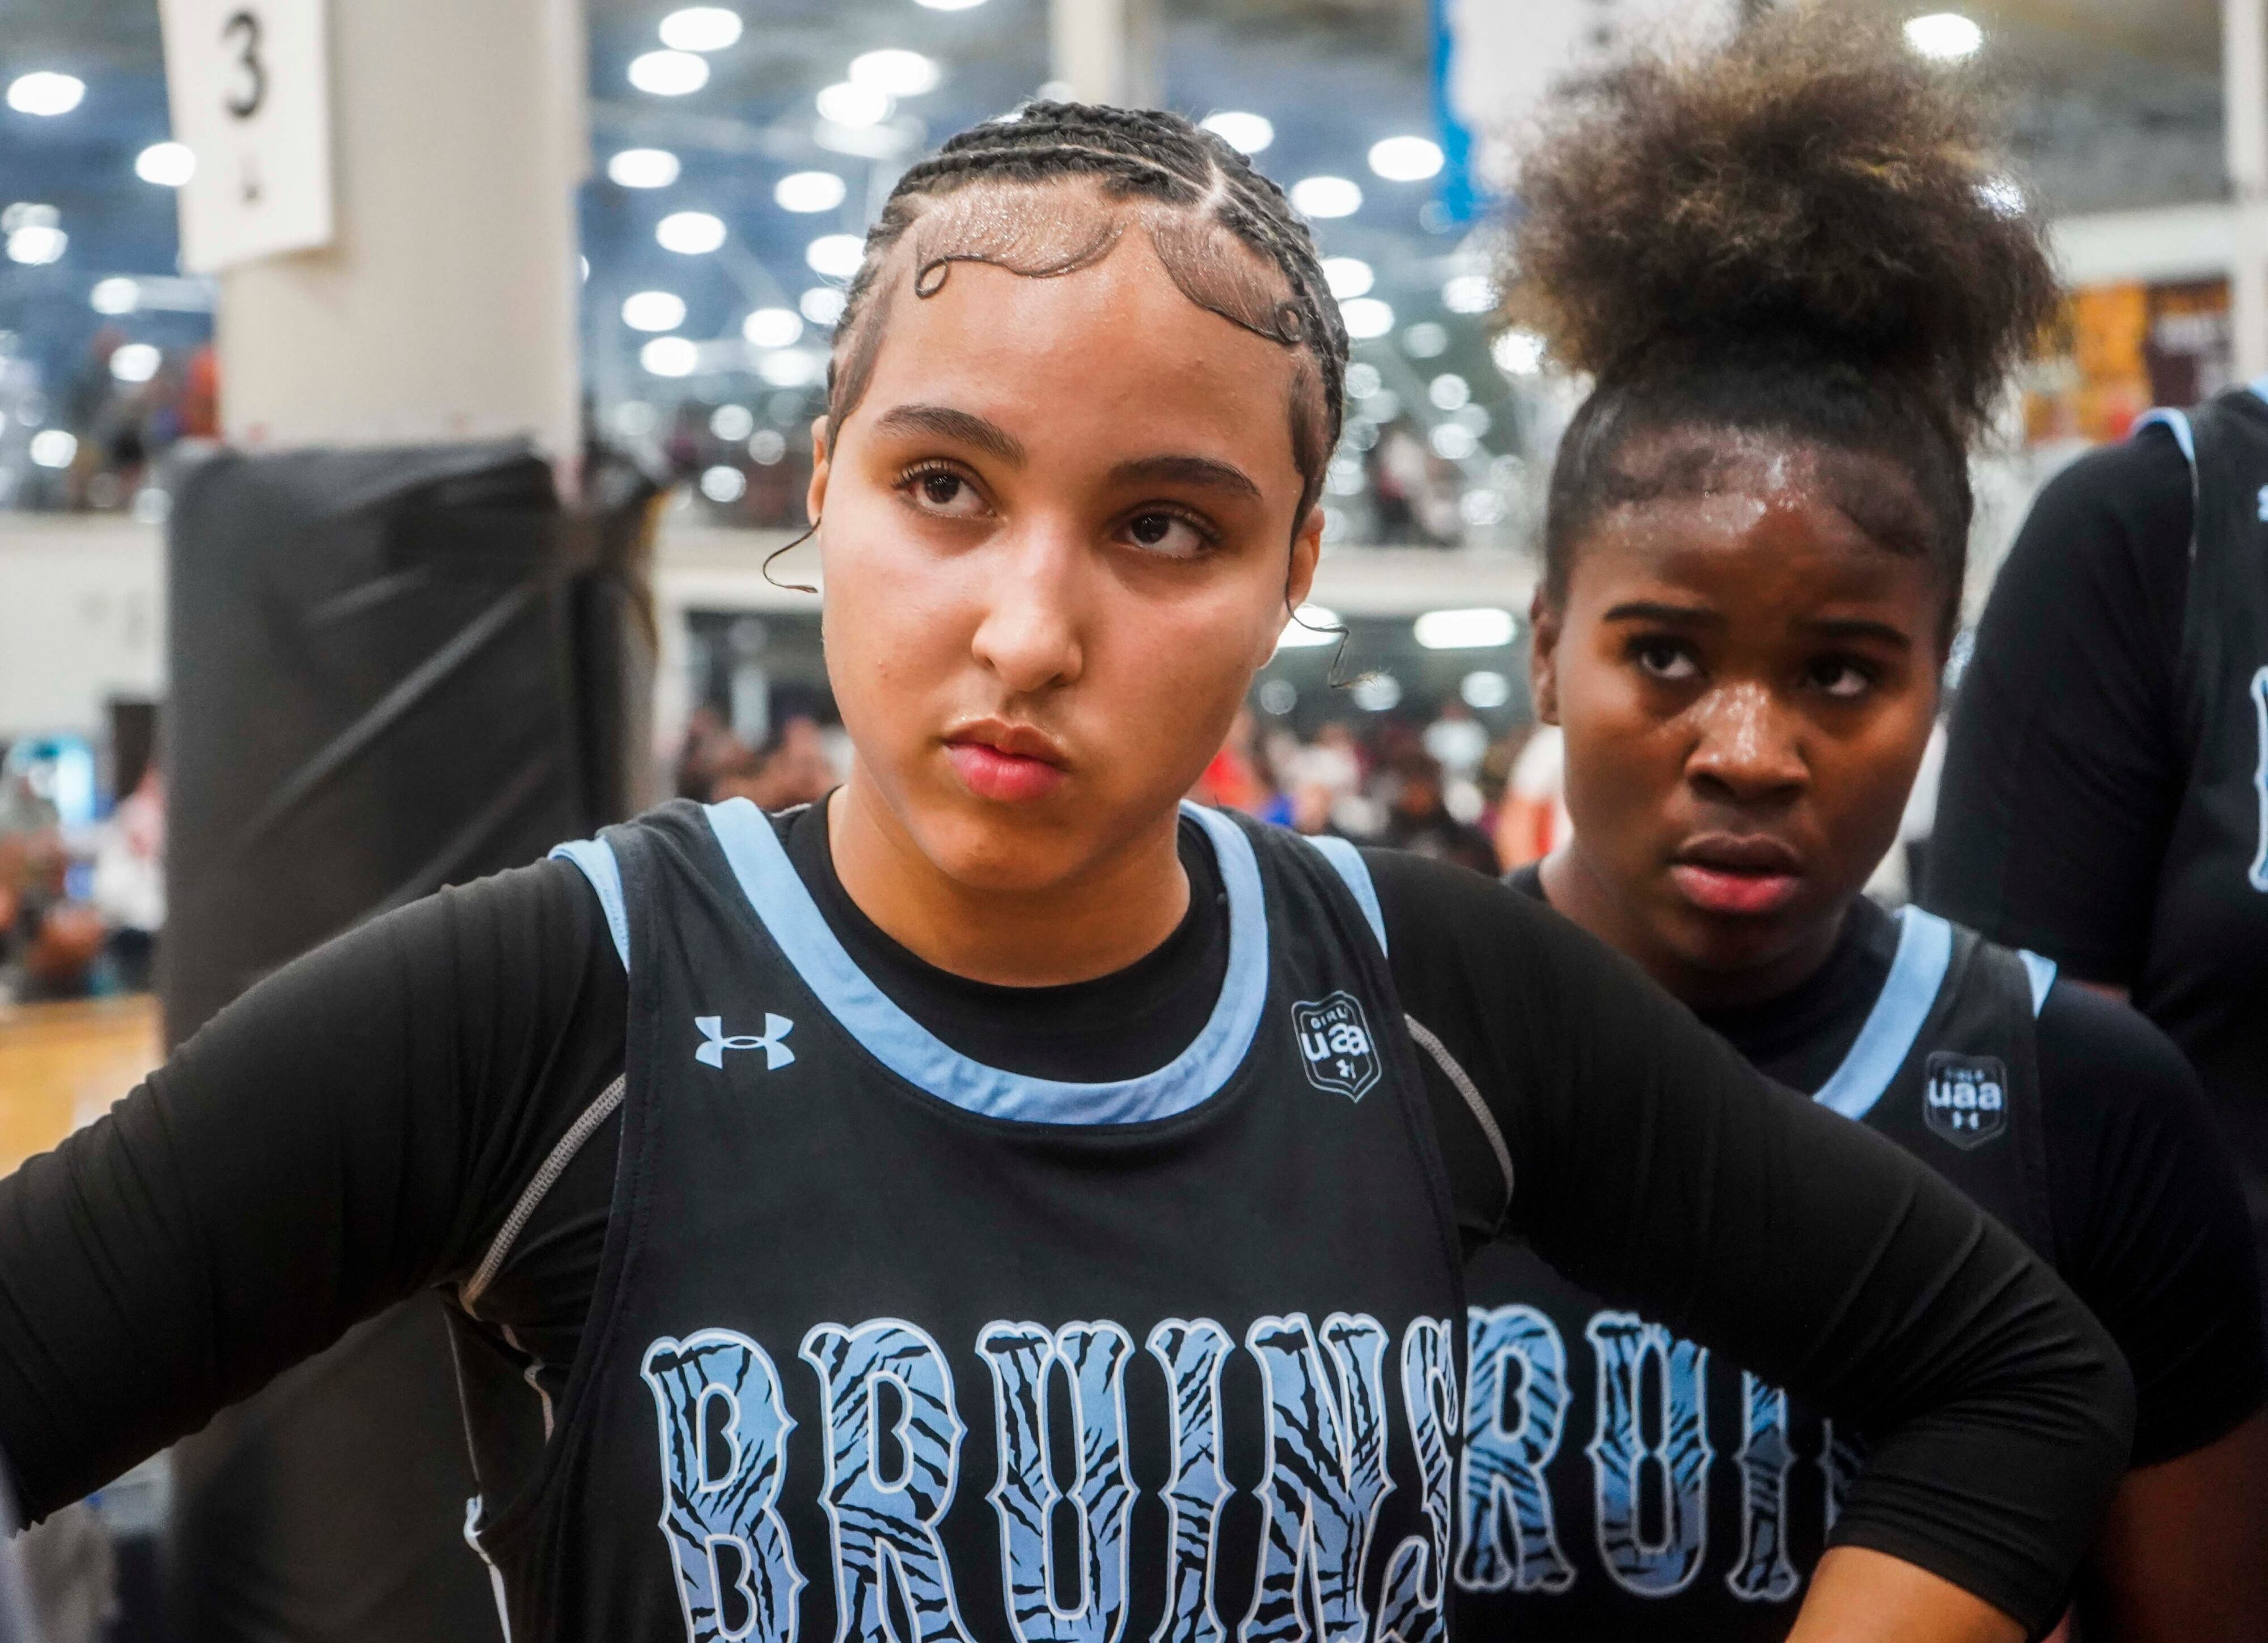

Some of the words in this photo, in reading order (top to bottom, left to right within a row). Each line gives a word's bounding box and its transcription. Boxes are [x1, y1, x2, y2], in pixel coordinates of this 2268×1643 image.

[221, 9, 269, 121] 3
[1300, 1022, 1370, 1061] uaa
[1929, 1077, 2002, 1111] uaa
[641, 1311, 1458, 1642] BRUINS
[1453, 1303, 1865, 1600] RUI
